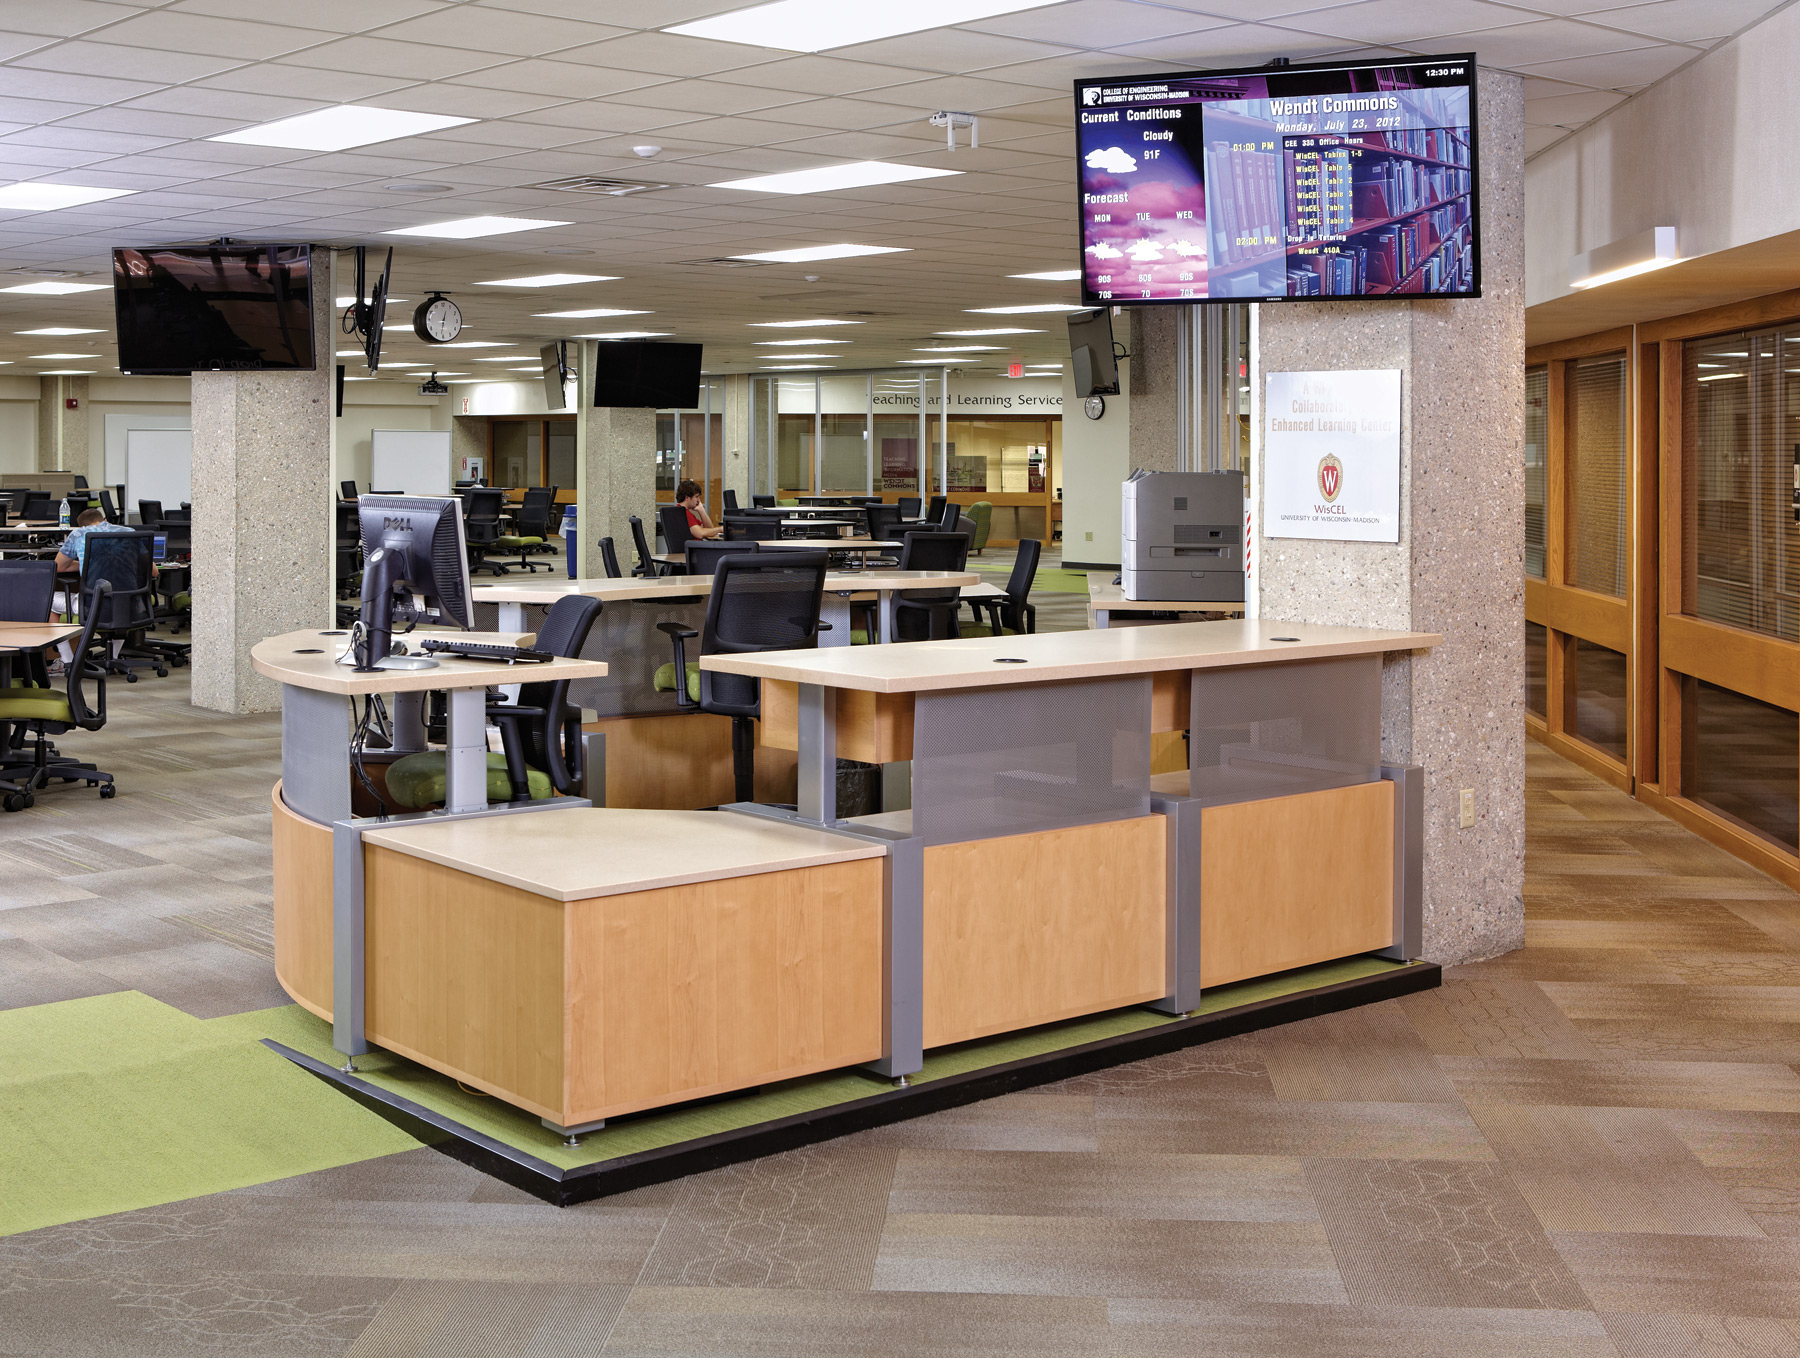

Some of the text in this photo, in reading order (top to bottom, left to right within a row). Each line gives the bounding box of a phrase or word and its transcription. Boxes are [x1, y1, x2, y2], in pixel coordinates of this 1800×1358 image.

[1425, 68, 1464, 77] 12:30 PM
[1129, 85, 1168, 94] ENGINEERING
[1103, 95, 1128, 103] UNIVERSITY
[1134, 91, 1189, 101] WISCONSIN-MADISON
[1270, 96, 1398, 116] Wendt Commons
[1082, 108, 1182, 124] Current Conditions
[1276, 117, 1400, 133] Monday, July 23, 2012
[1144, 130, 1173, 141] Cloudy
[1233, 142, 1274, 152] 01:00 PM
[1144, 150, 1160, 160] 91F
[1084, 192, 1128, 204] Forecast
[1094, 210, 1193, 222] MON TUE WED
[1236, 236, 1277, 245] 02:00 PM
[1319, 233, 1346, 242] Tutoring
[1098, 275, 1111, 283] 90S
[1180, 273, 1193, 281] 90S
[1098, 290, 1112, 299] 70S
[1180, 288, 1194, 297] 70S
[1010, 365, 1022, 376] EXIT
[866, 394, 921, 408] eaching
[957, 395, 1012, 408] Learning
[1018, 394, 1063, 405] Service
[1272, 418, 1392, 433] Enhanced Learning Center
[1324, 470, 1337, 492] W
[1314, 505, 1346, 514] WisCEL
[384, 517, 413, 531] DELL
